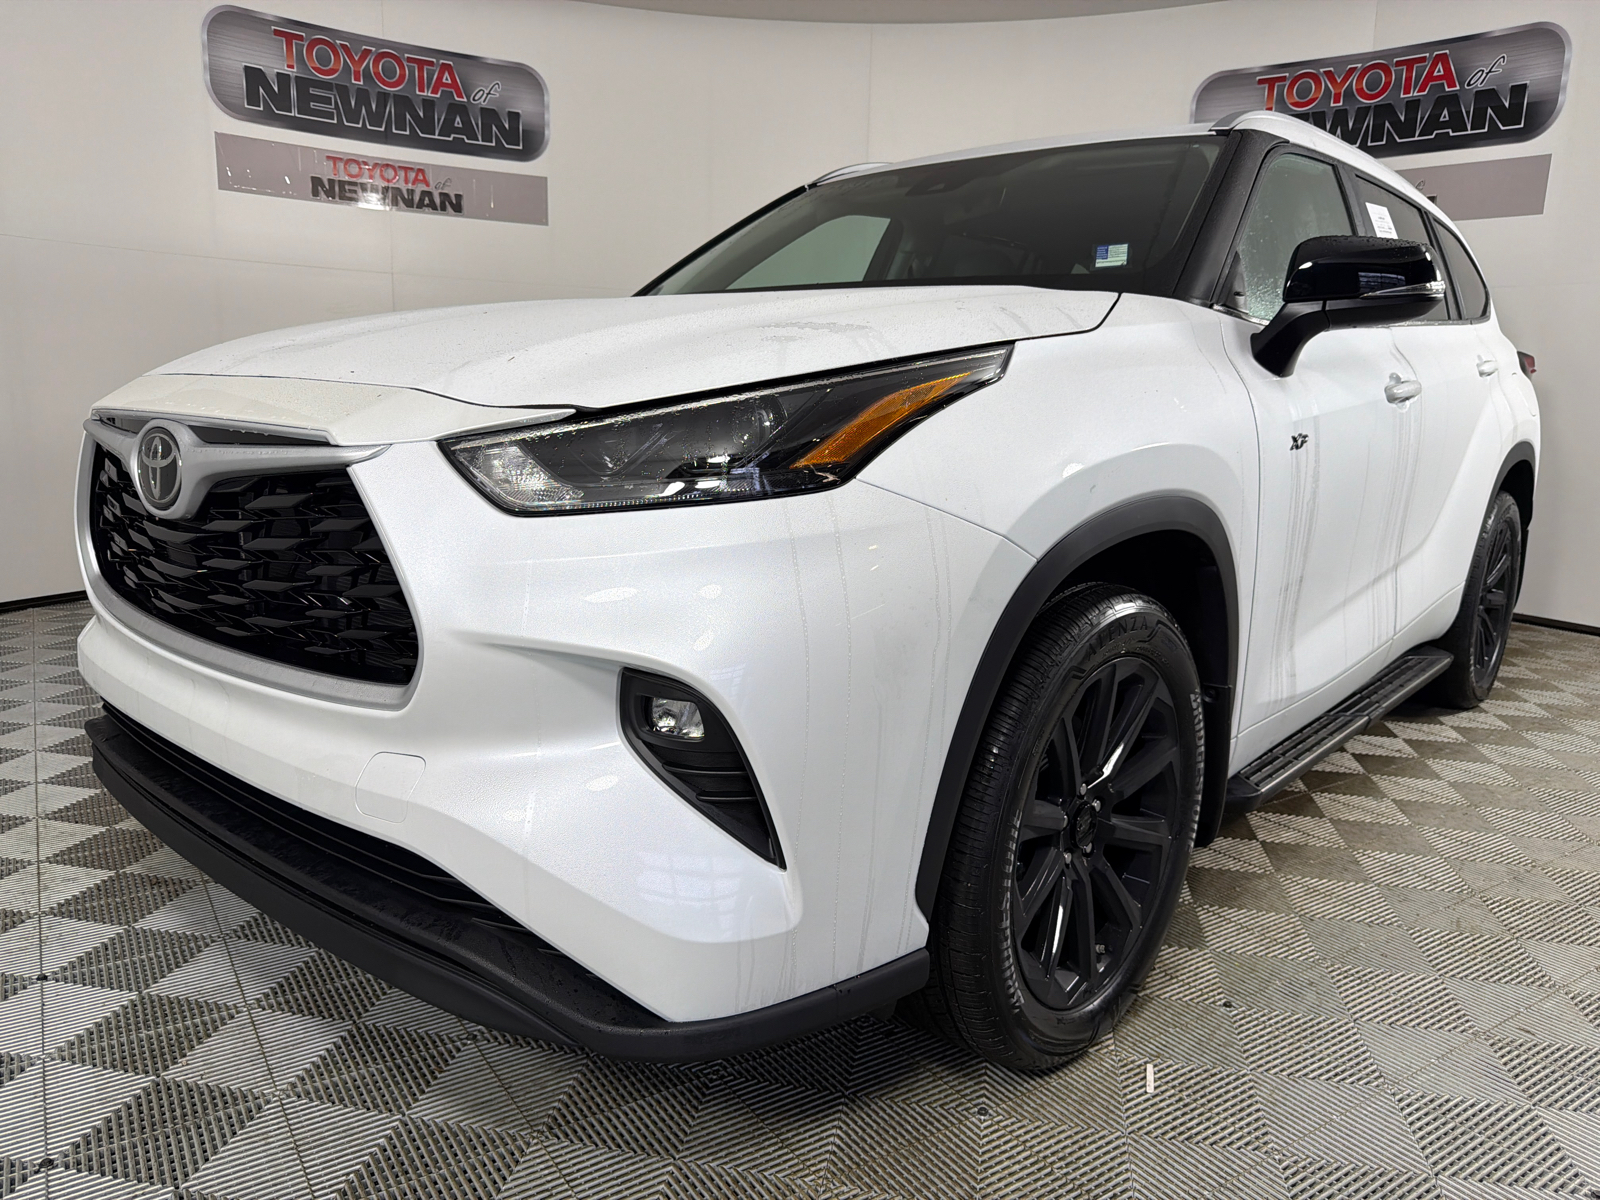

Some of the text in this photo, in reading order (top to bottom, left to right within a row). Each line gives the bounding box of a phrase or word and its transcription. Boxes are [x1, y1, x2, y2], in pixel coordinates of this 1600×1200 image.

[271, 26, 500, 105] TOYOTA of
[1257, 50, 1507, 112] TOYOTA of
[243, 64, 523, 149] NEWNAN
[1288, 81, 1529, 147] WNAN
[326, 155, 430, 188] TOYOTA
